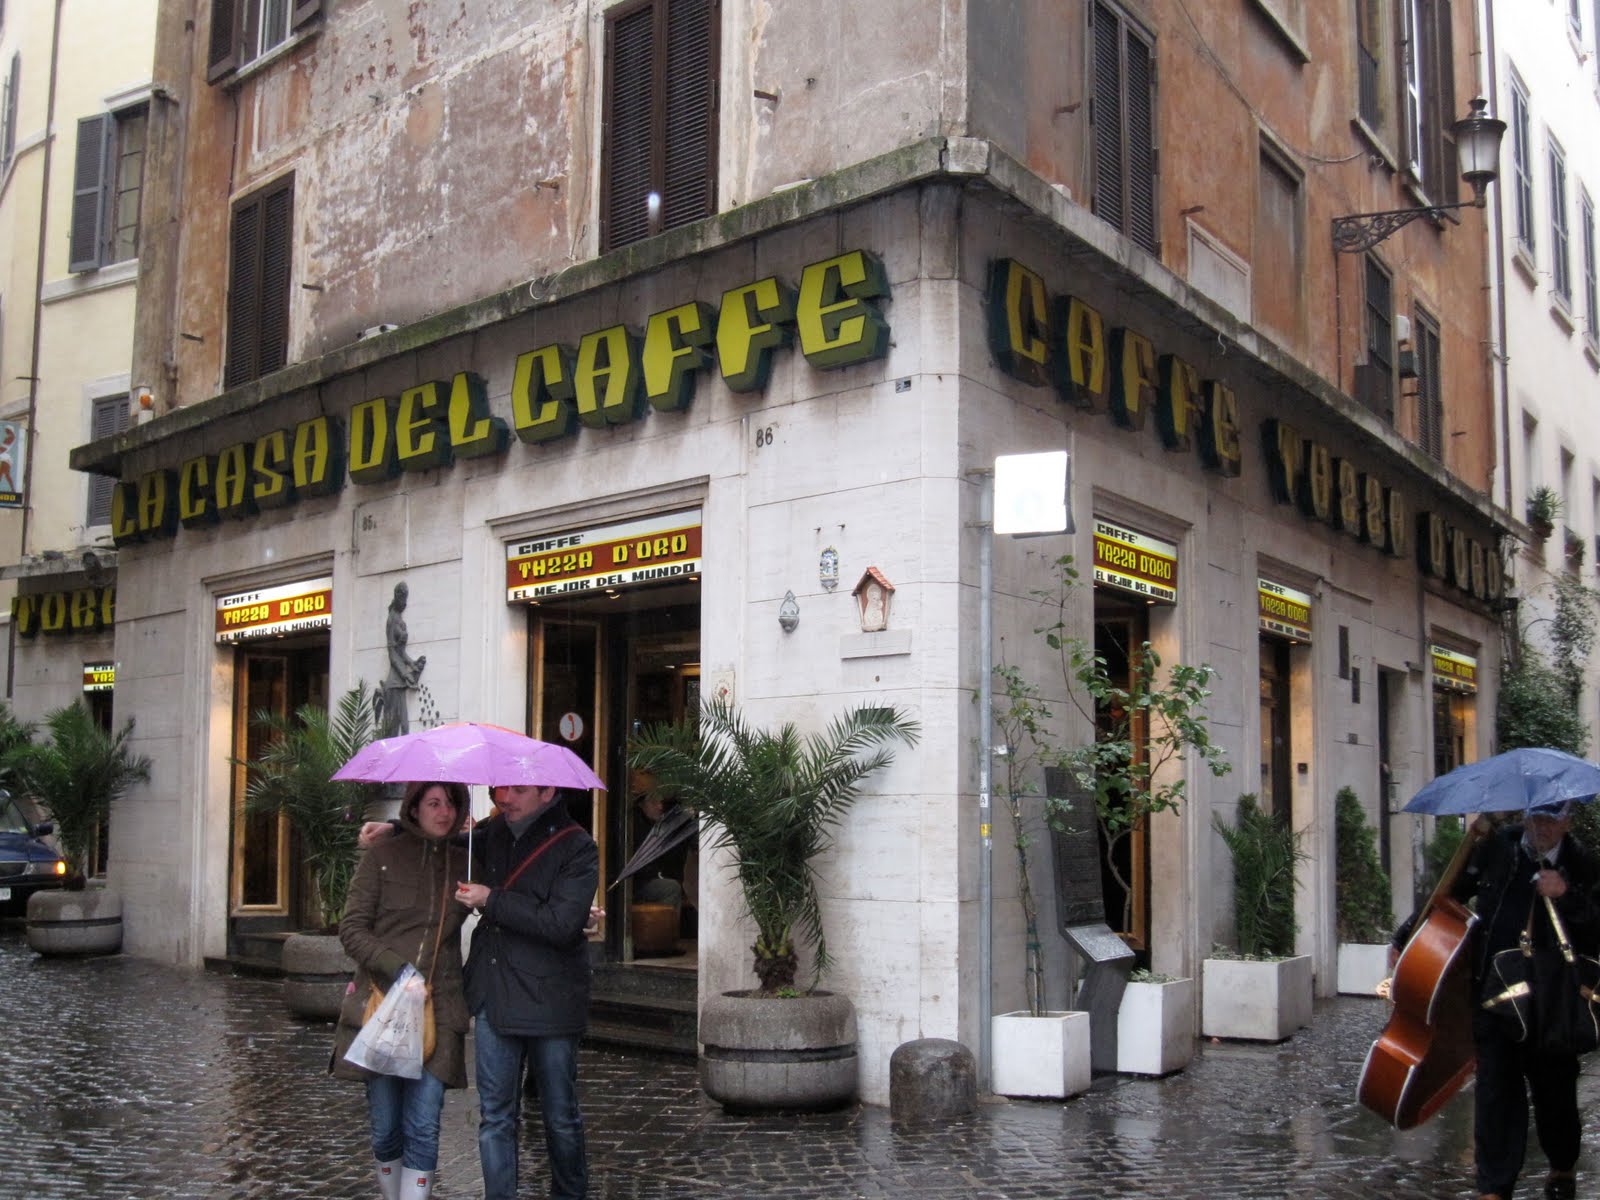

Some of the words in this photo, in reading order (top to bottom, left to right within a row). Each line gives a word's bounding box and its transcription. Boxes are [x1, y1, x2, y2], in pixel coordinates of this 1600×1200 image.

[996, 258, 1240, 470] CAFFE
[112, 468, 172, 542] LA
[179, 416, 337, 526] CASA
[348, 371, 500, 478] DEL
[511, 250, 880, 438] CAFFE
[756, 427, 773, 448] 86
[518, 551, 594, 579] TAZZA
[612, 534, 688, 564] D'ORO
[1097, 541, 1136, 570] TAZZA
[1140, 554, 1171, 580] D'ORO
[514, 590, 530, 600] EL
[534, 580, 590, 597] MEJOR
[596, 573, 626, 587] DEL
[632, 563, 695, 581] MUNDO
[1096, 571, 1105, 581] EL
[1107, 573, 1132, 589] MEJOR
[1135, 581, 1148, 593] DEL
[223, 604, 269, 625] TAZZA
[279, 594, 325, 617] D'ORO
[220, 633, 230, 642] EL
[233, 627, 268, 639] MEJOR
[271, 624, 289, 635] DEL
[291, 618, 328, 630] MUNDO
